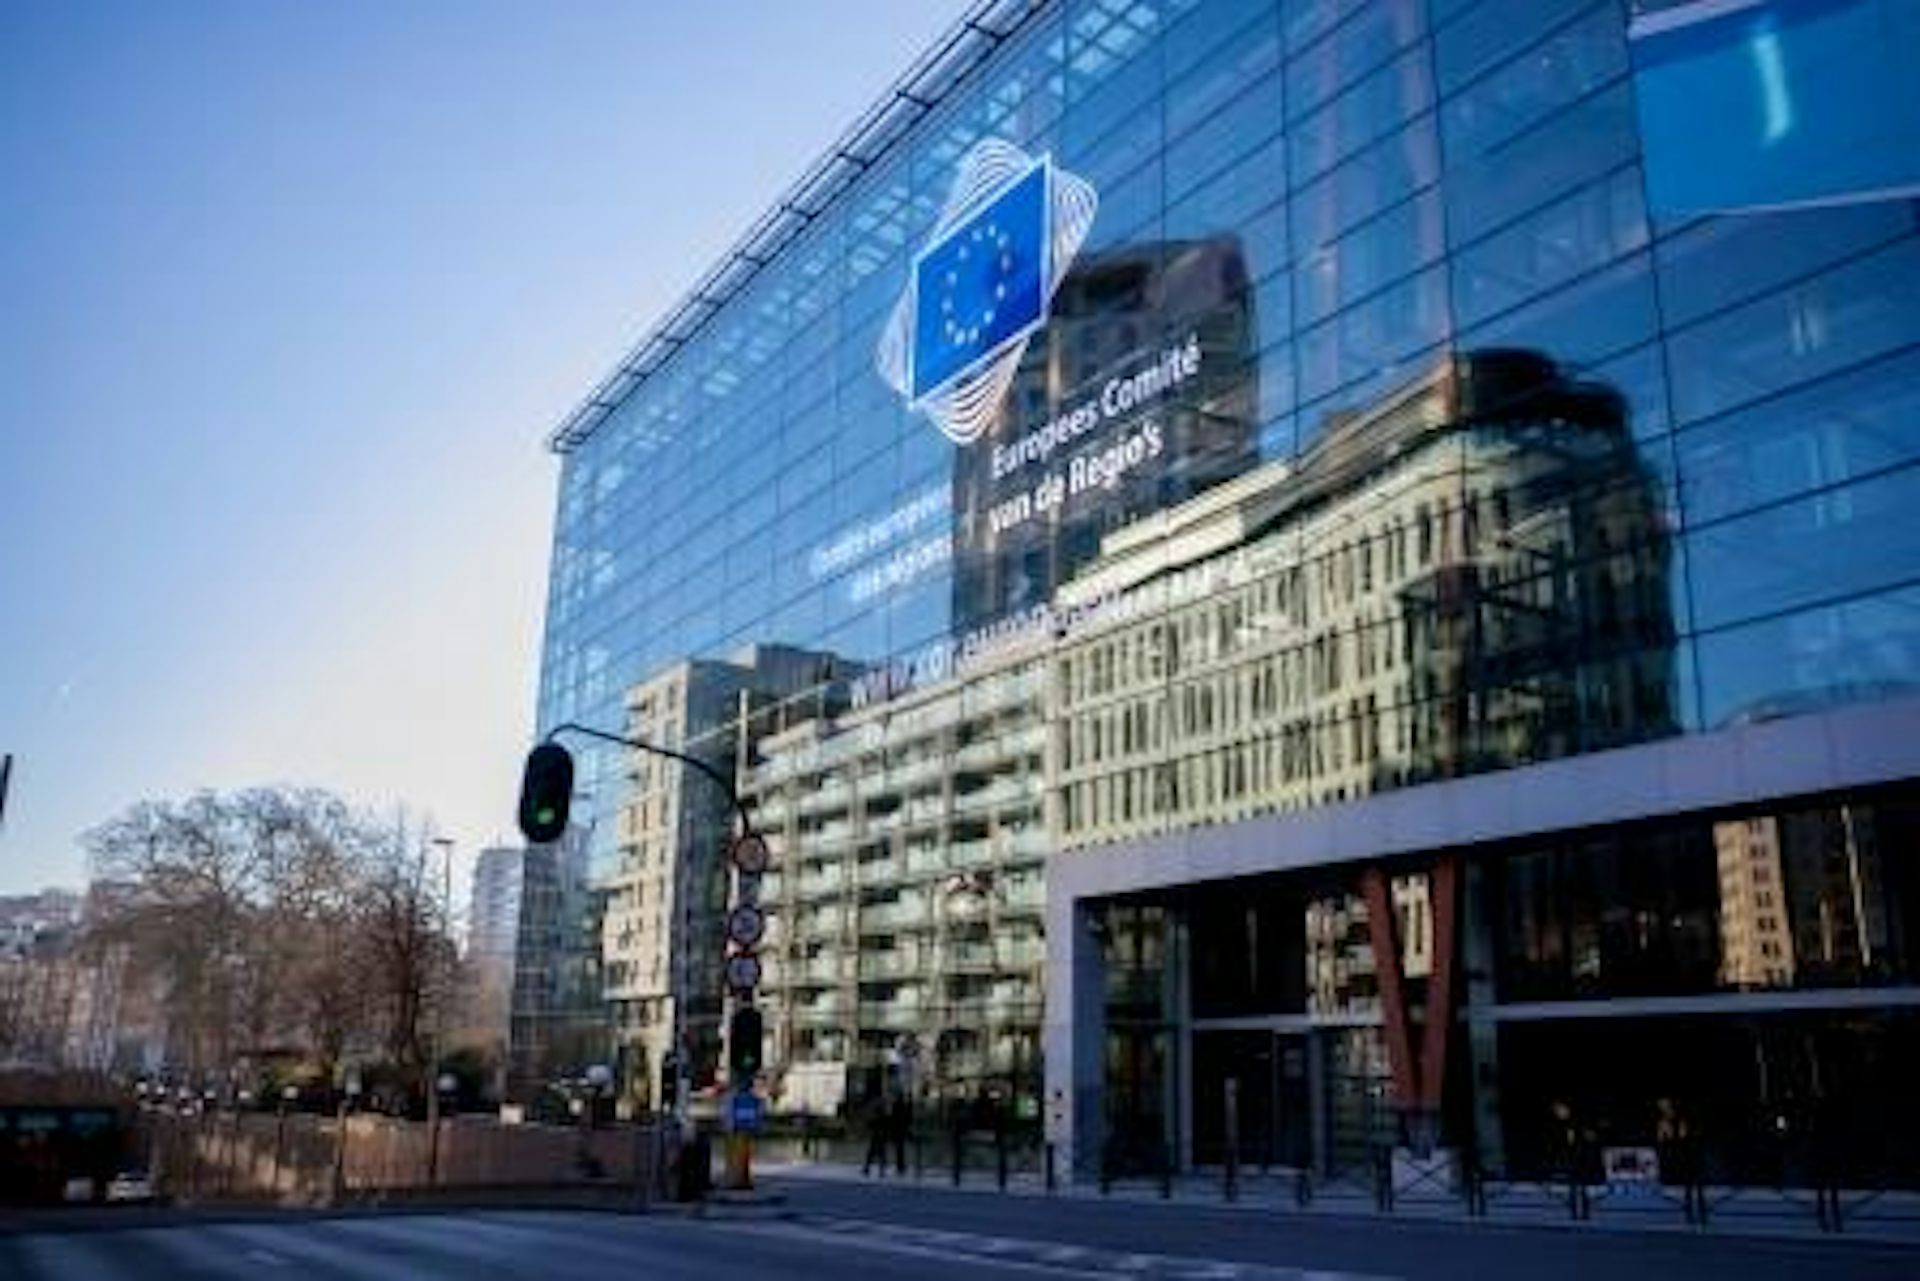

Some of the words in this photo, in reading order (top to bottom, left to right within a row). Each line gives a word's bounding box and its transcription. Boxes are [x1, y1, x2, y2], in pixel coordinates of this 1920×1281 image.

[993, 401, 1099, 478] Europees
[1101, 333, 1200, 417] Comité
[989, 493, 1031, 533] van
[1034, 471, 1065, 511] de
[1069, 421, 1165, 495] Regio's
